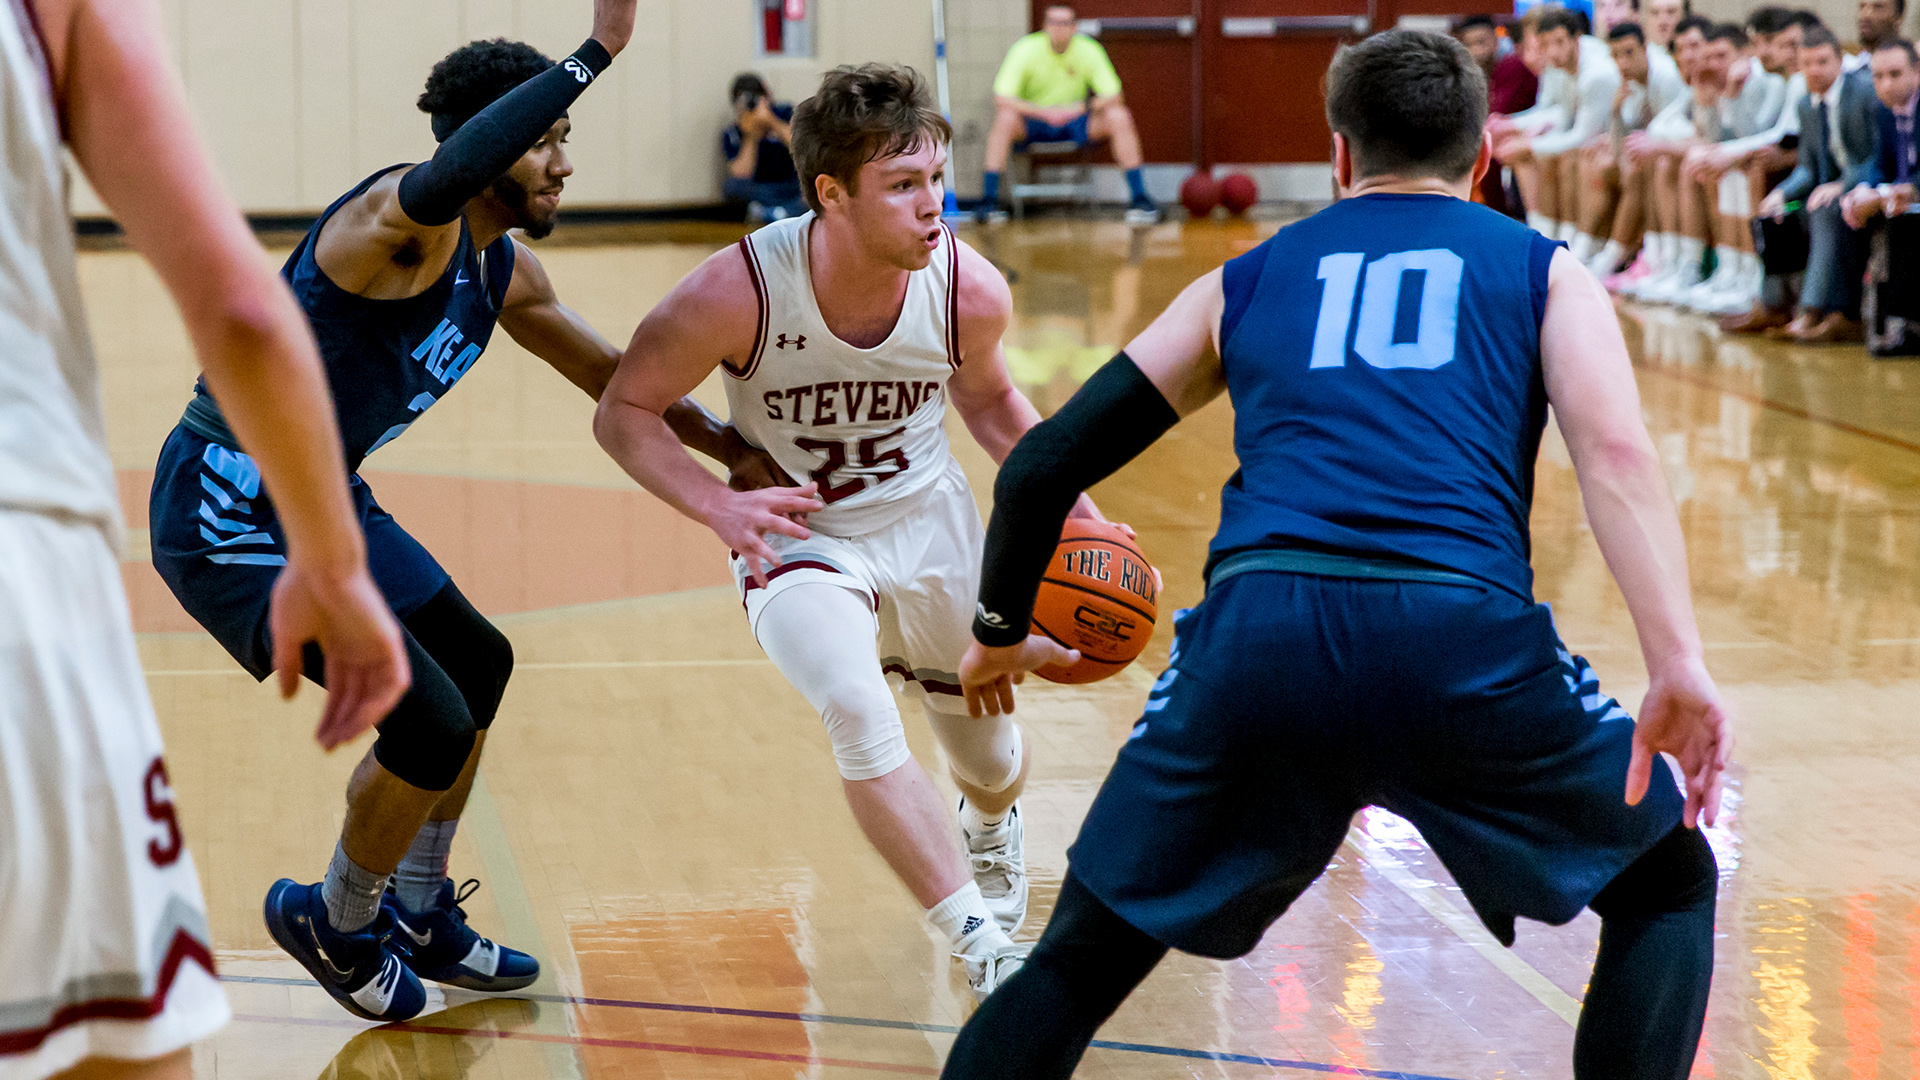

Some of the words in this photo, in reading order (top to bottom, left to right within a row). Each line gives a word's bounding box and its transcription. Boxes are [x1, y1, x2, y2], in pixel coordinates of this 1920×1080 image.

[1309, 248, 1464, 370] 10
[792, 426, 911, 504] 25
[1062, 549, 1112, 582] THE
[143, 756, 182, 868] S
